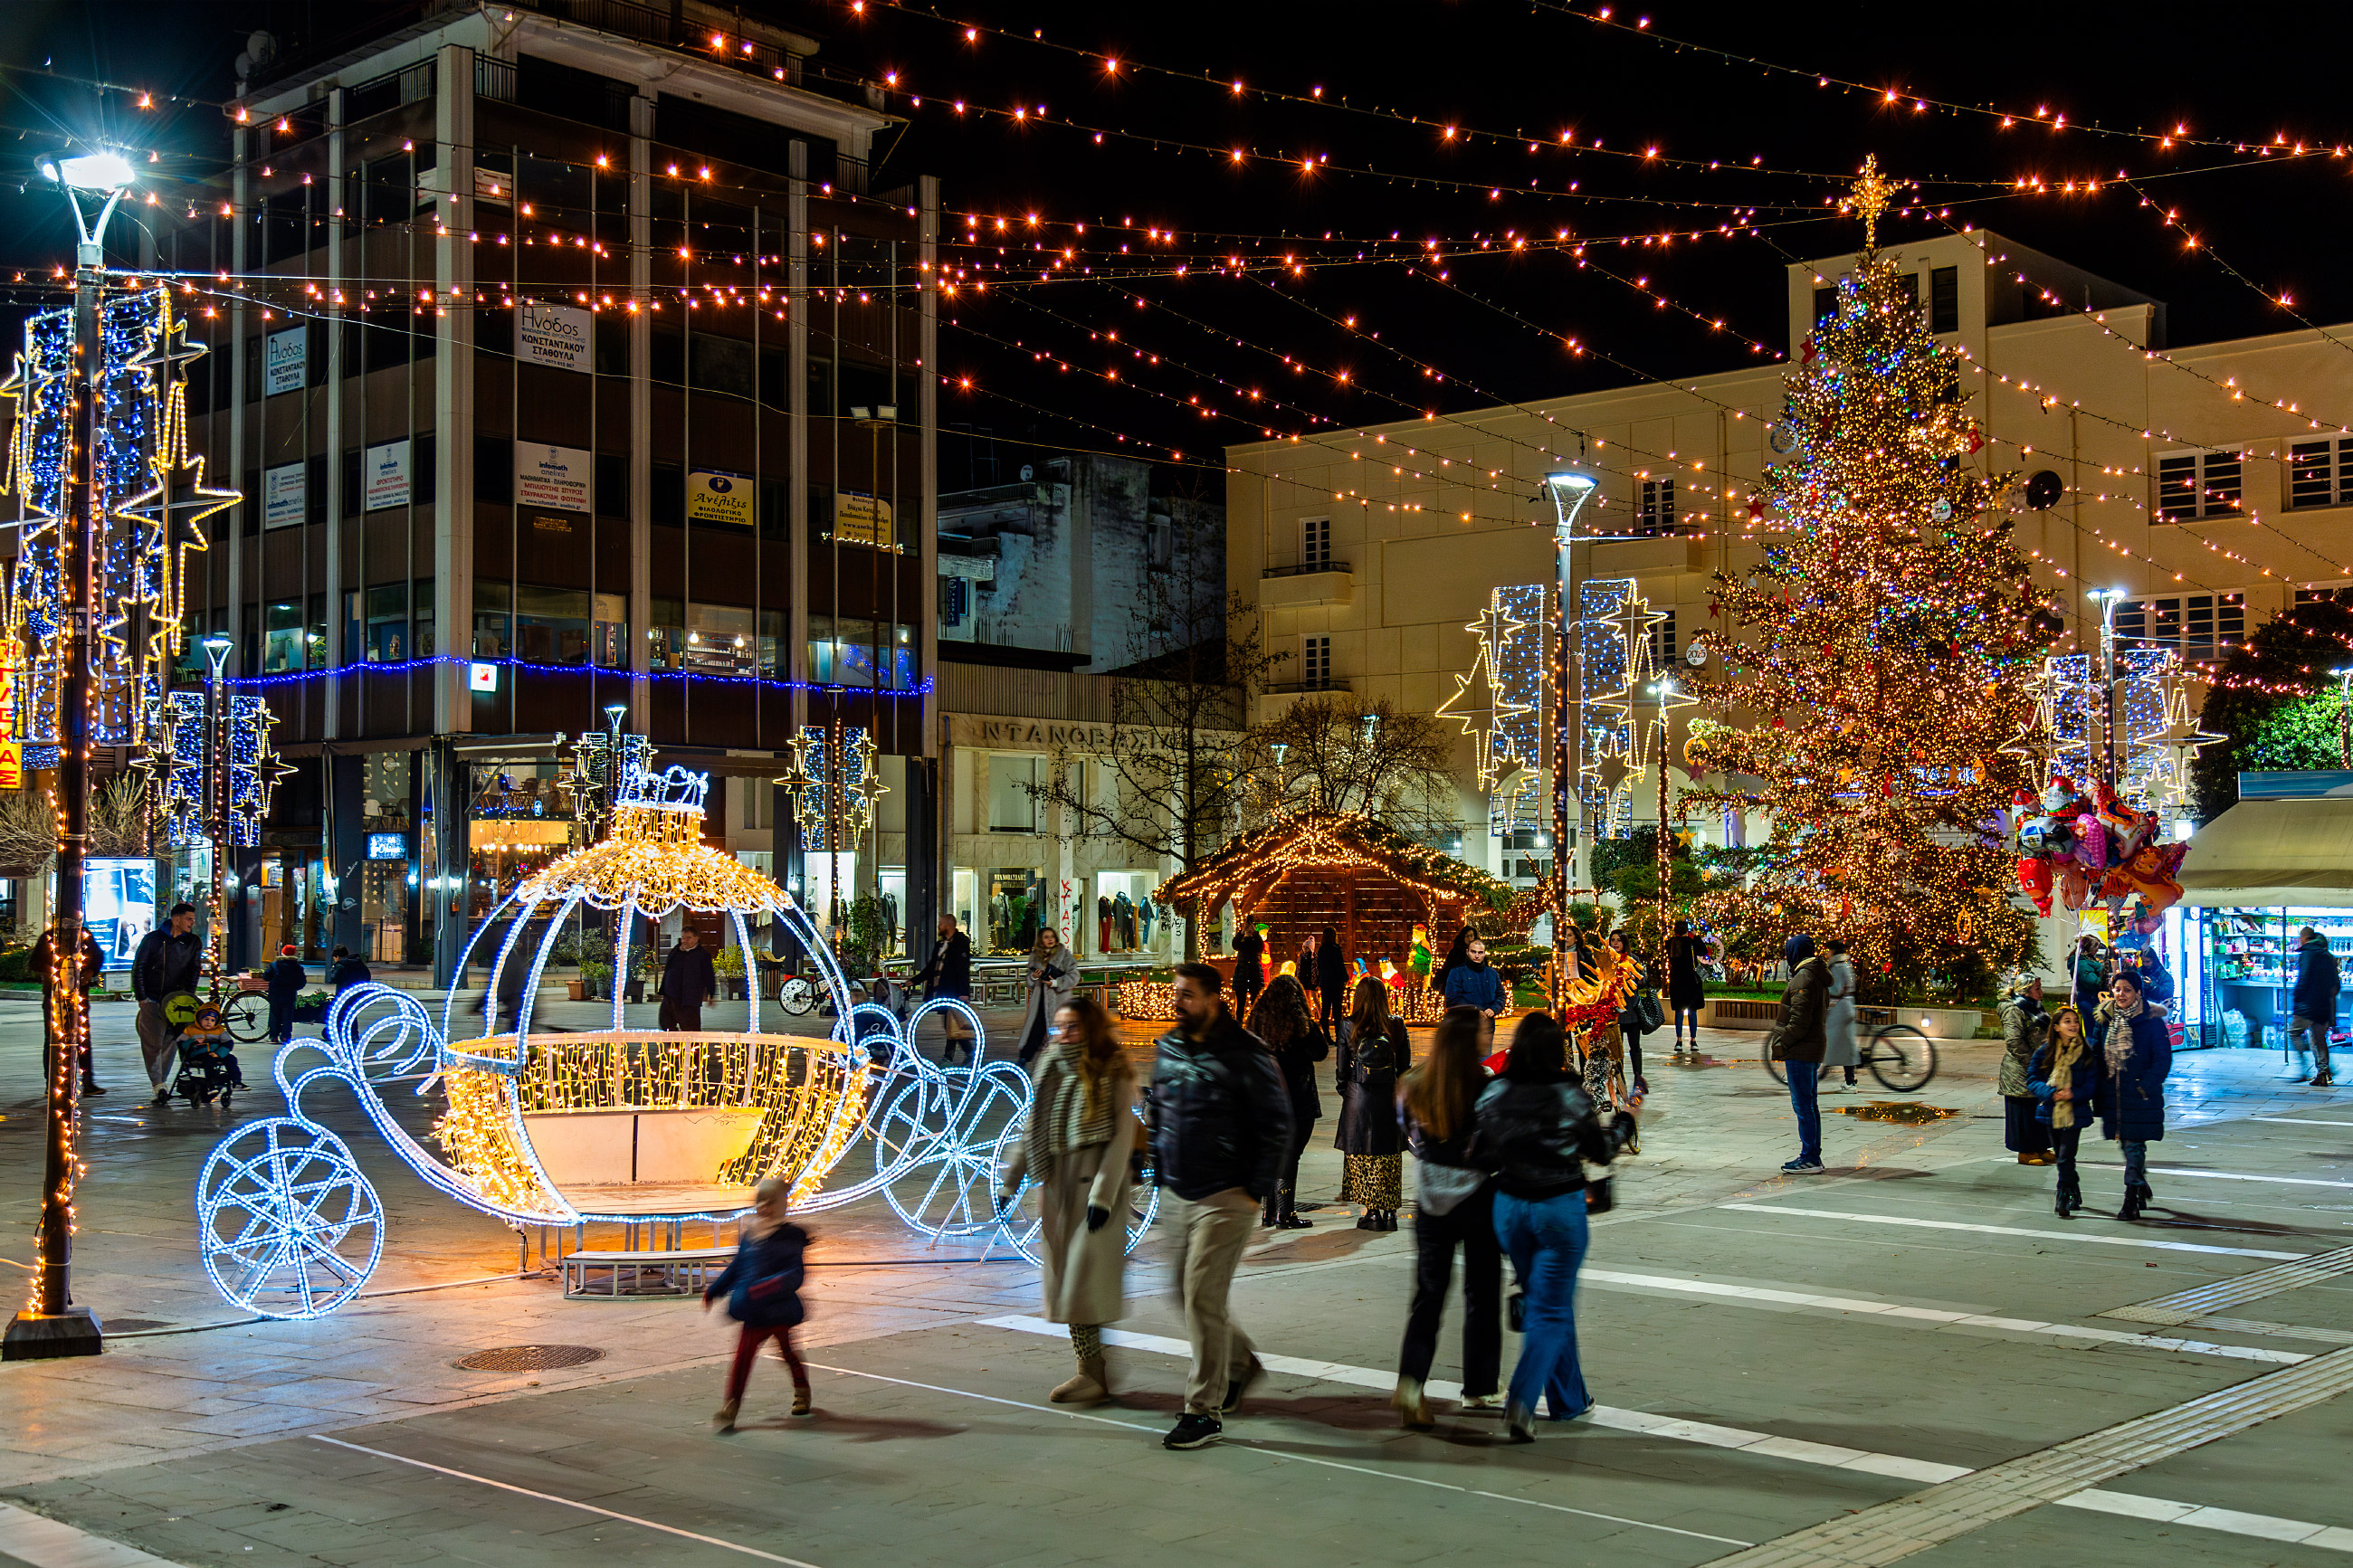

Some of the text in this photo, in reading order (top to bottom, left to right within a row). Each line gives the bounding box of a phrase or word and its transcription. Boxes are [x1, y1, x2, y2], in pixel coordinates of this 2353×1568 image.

[521, 334, 585, 353] ΚΩΝΣΤΑΝΤΑΚΟΥ
[532, 346, 575, 361] ΣΤΑΘΟΥΛΑ
[538, 461, 567, 471] infomath
[520, 474, 550, 484] ΜΑΘΗΜΑΤΙΚΑ
[561, 488, 583, 496] ΣΠΥΡΟΣ
[561, 495, 586, 504] ΦΩΤΕΙΝΗ
[694, 493, 747, 509] Ανέλιξις
[698, 506, 742, 517] ΦΙΛΟΛΟΓΙΚΟ
[693, 511, 747, 523] ΦΡΟΝΤΙΣΤΗΡΙΟ
[1688, 650, 1706, 659] 2025
